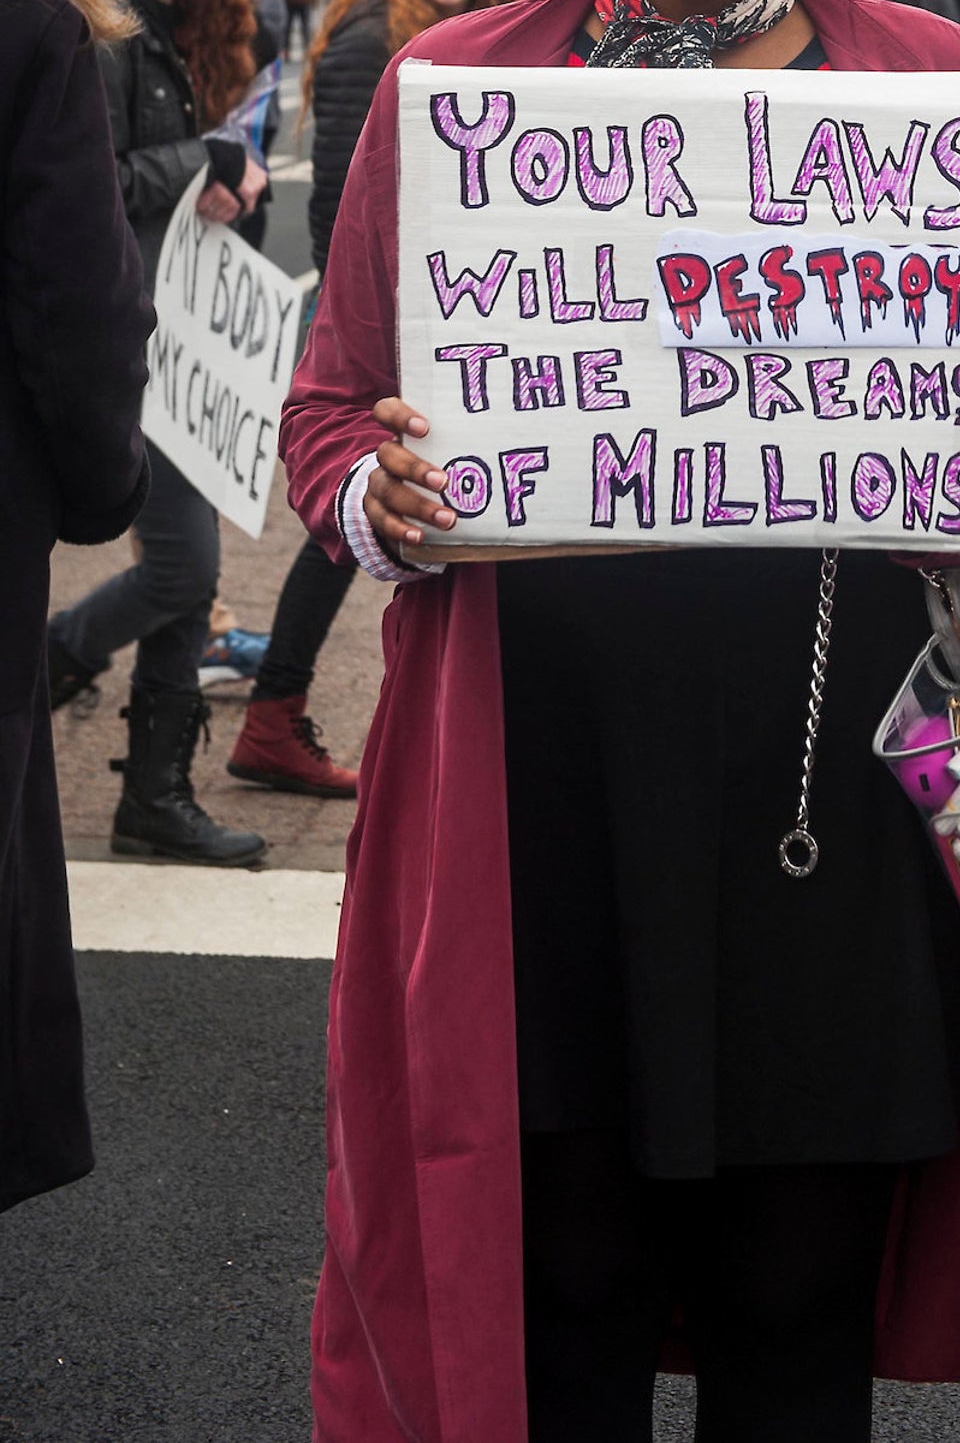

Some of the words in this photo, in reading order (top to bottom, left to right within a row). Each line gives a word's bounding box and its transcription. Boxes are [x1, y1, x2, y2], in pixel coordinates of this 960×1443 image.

[430, 91, 697, 218] YOUR
[165, 210, 207, 316] MY
[210, 240, 294, 383] BODY
[427, 244, 649, 324] WILL
[148, 327, 183, 422] MY
[186, 360, 273, 501] CHOICE
[435, 344, 631, 413] THE
[441, 447, 550, 527] OF
